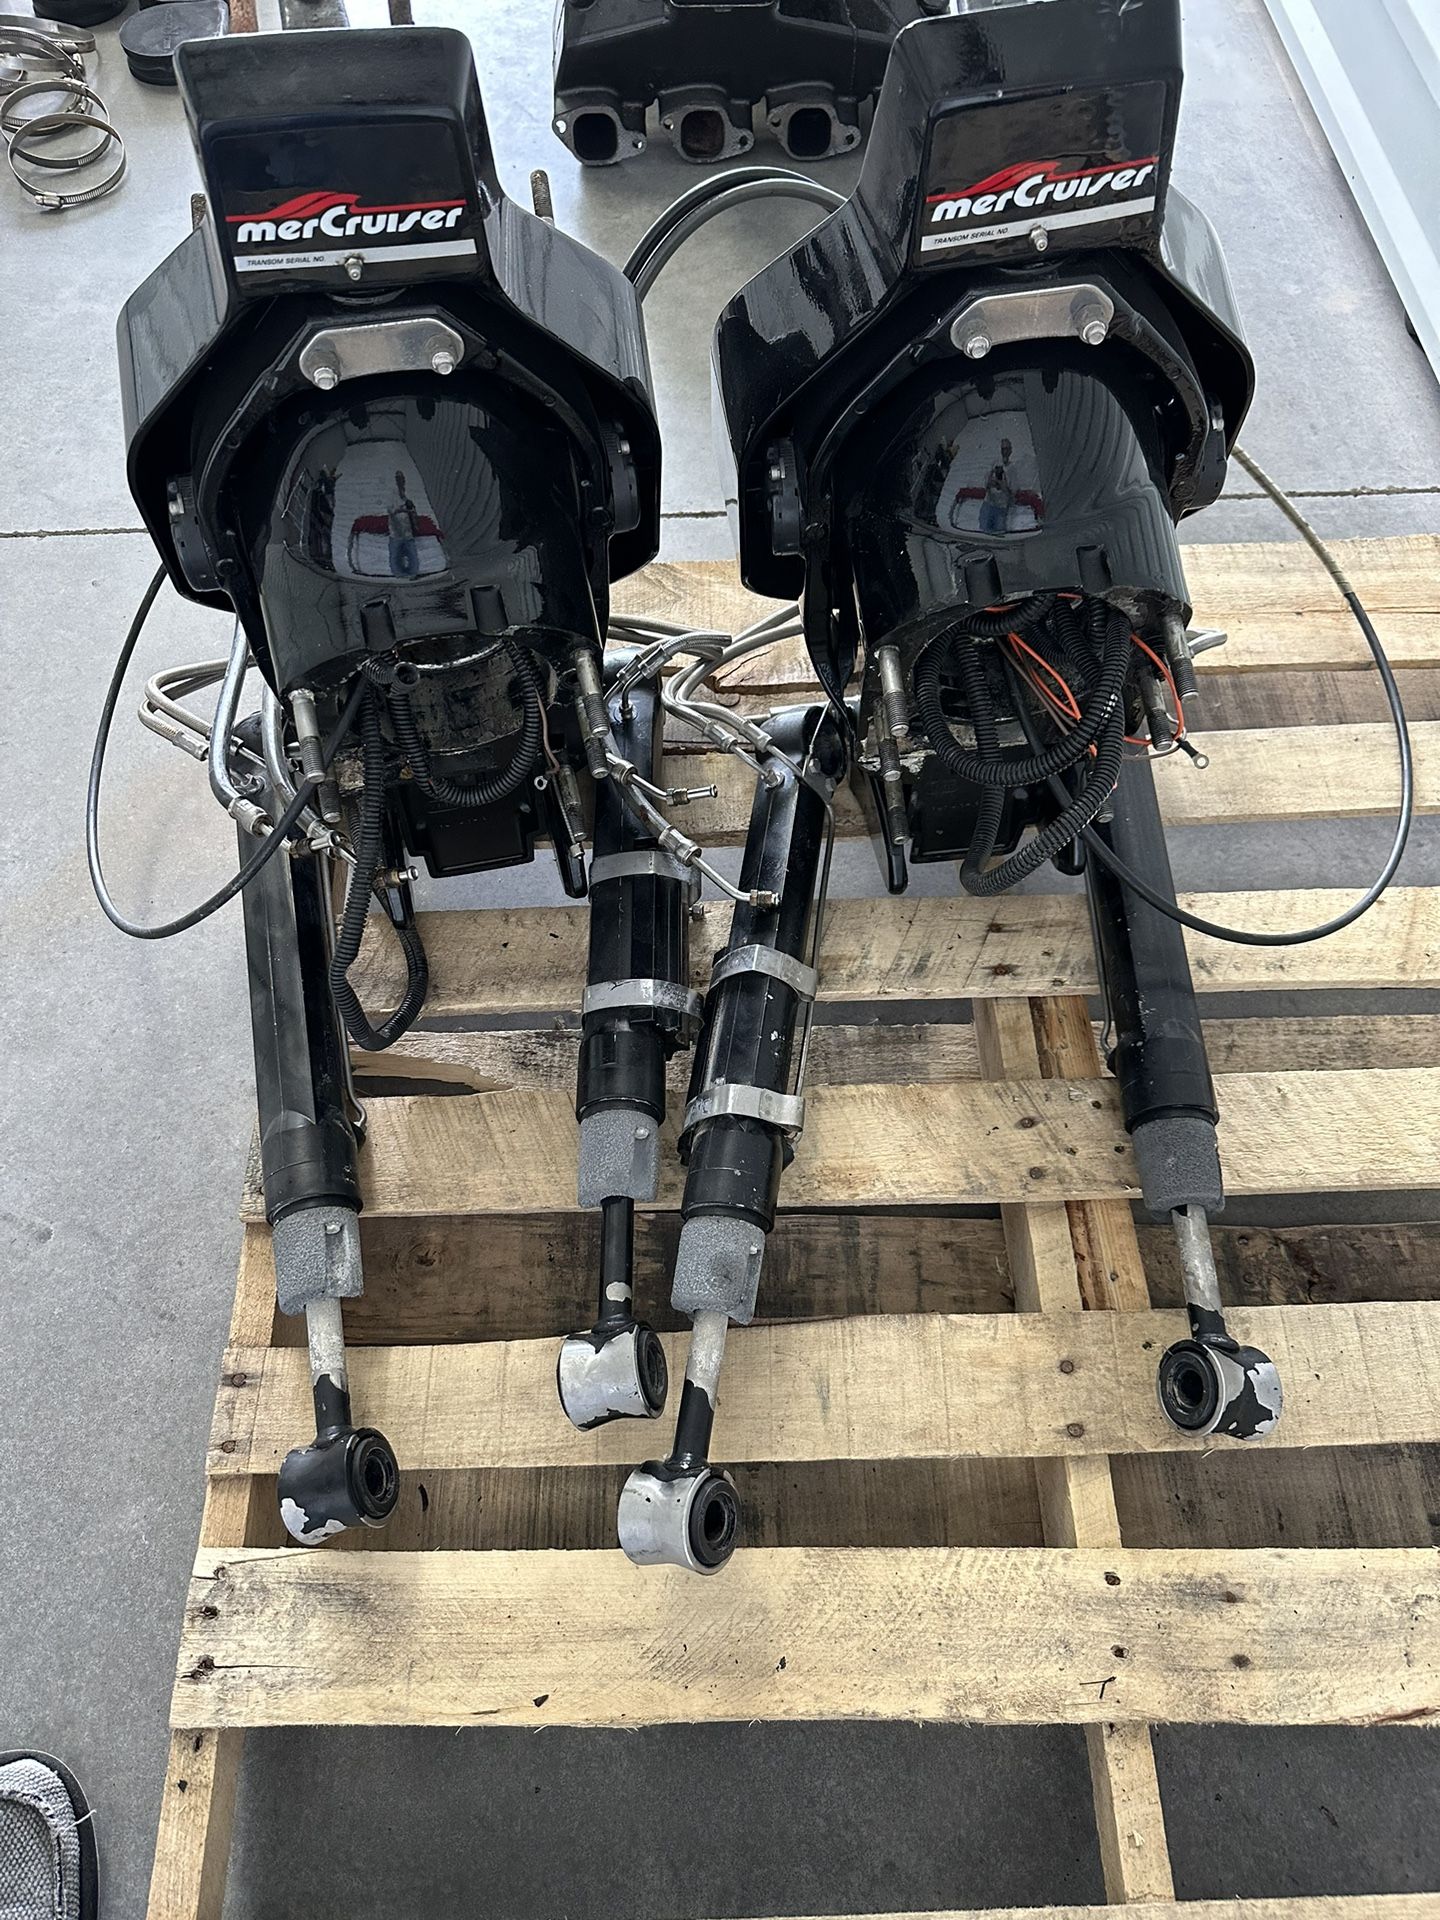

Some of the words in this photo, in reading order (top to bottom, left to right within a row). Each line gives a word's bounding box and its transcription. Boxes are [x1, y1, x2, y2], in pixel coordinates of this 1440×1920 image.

[934, 233, 969, 245] TRANSOM
[970, 229, 995, 240] SERIAL
[247, 257, 284, 266] TRANSOM
[285, 256, 311, 264] SERIAL
